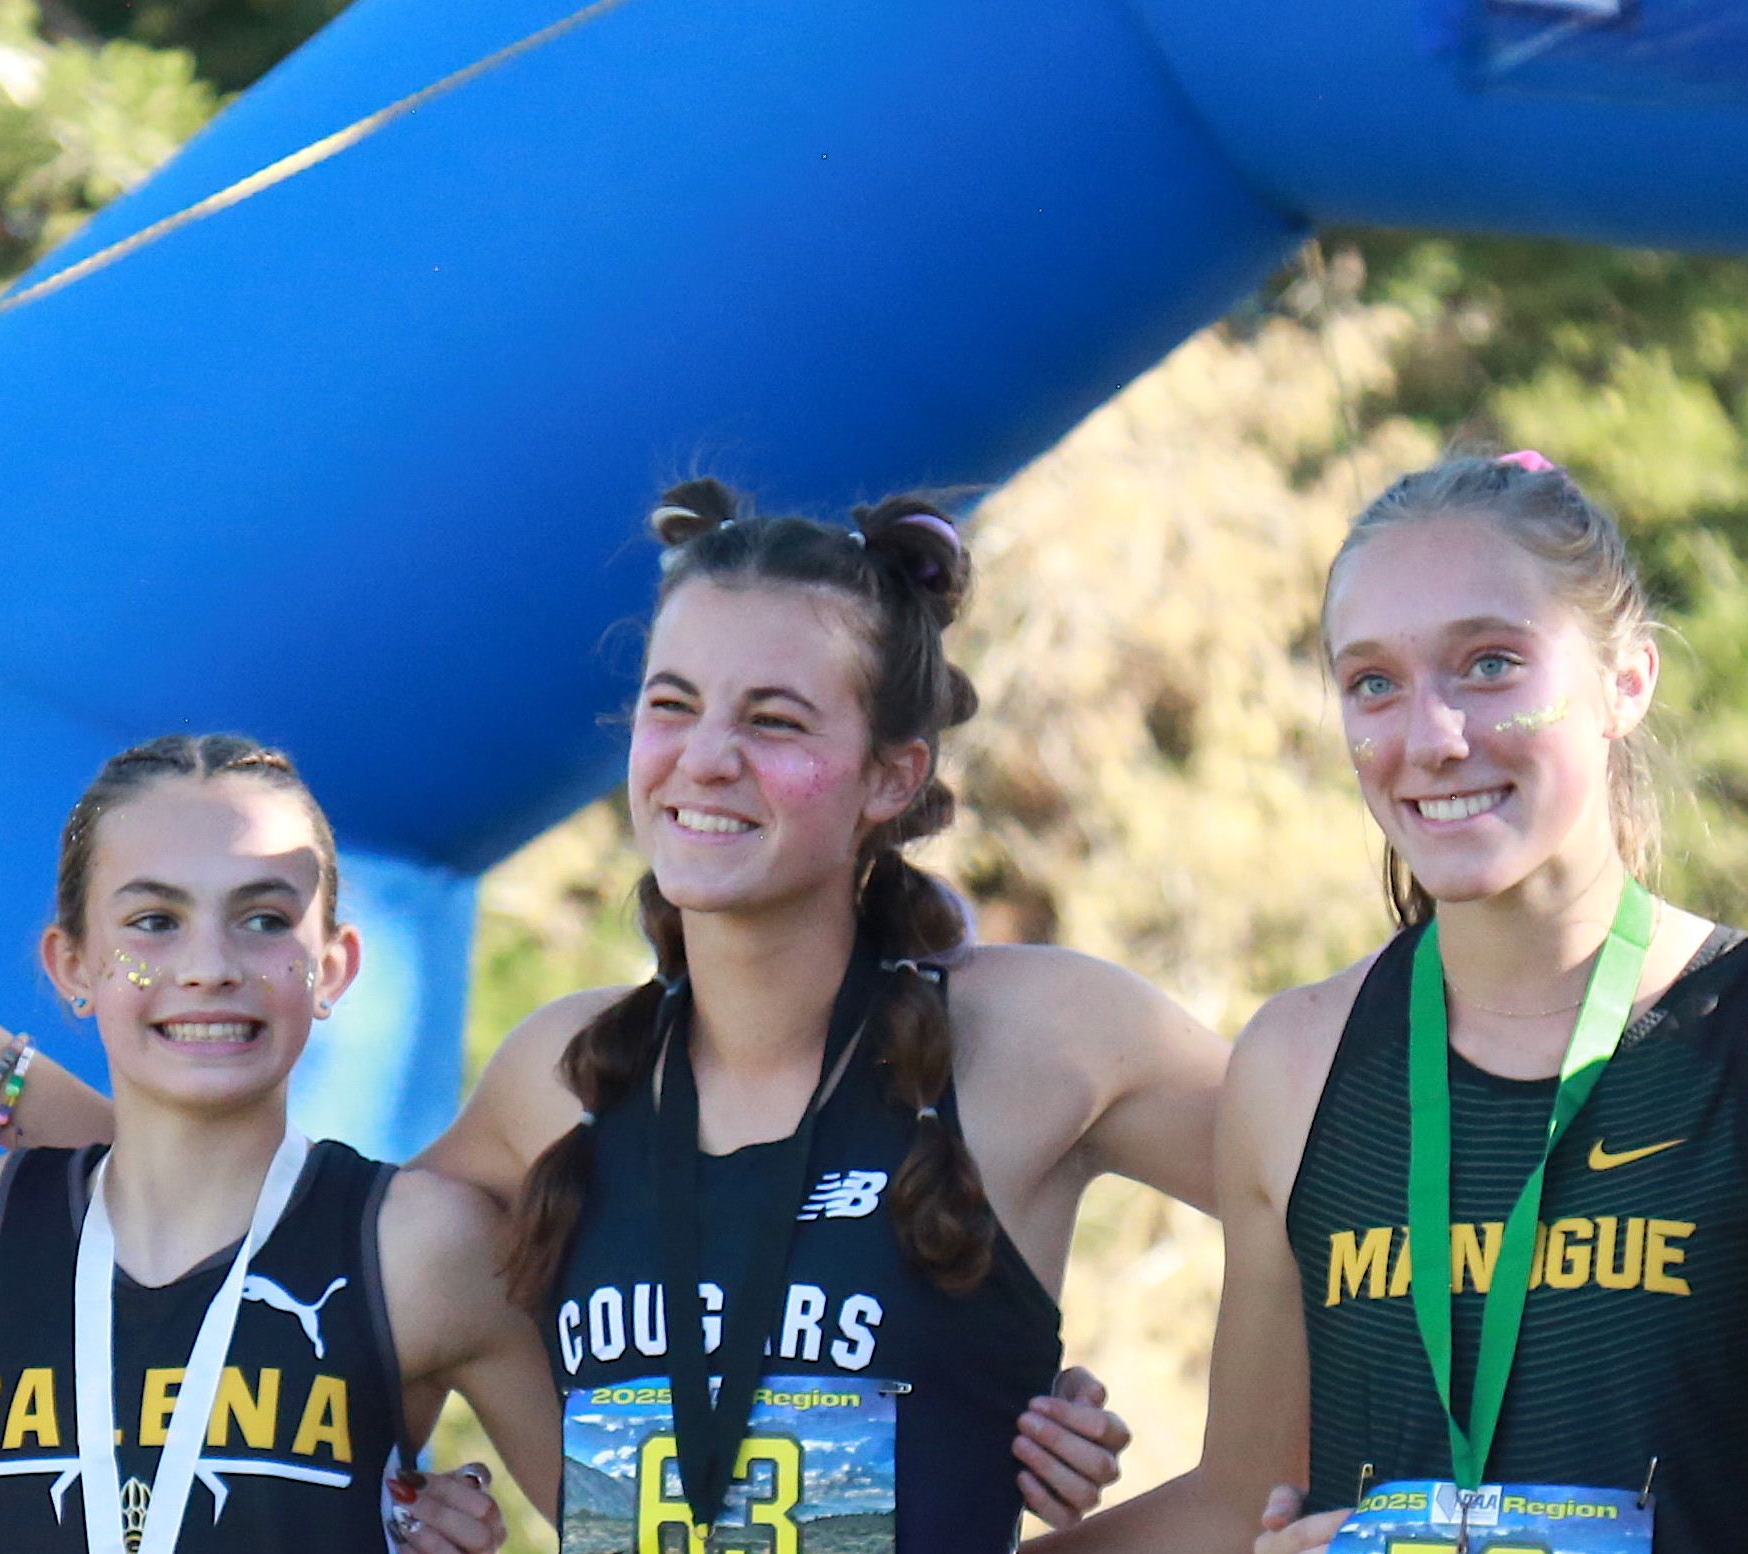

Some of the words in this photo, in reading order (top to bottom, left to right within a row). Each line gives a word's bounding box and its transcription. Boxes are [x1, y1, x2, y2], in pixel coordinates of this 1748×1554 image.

[1325, 1216, 1697, 1308] MNGUE
[558, 1282, 884, 1376] COUGRS
[591, 1387, 672, 1405] 2025
[753, 1388, 861, 1411] Region
[1356, 1493, 1428, 1513] 2025
[1503, 1496, 1619, 1520] Region
